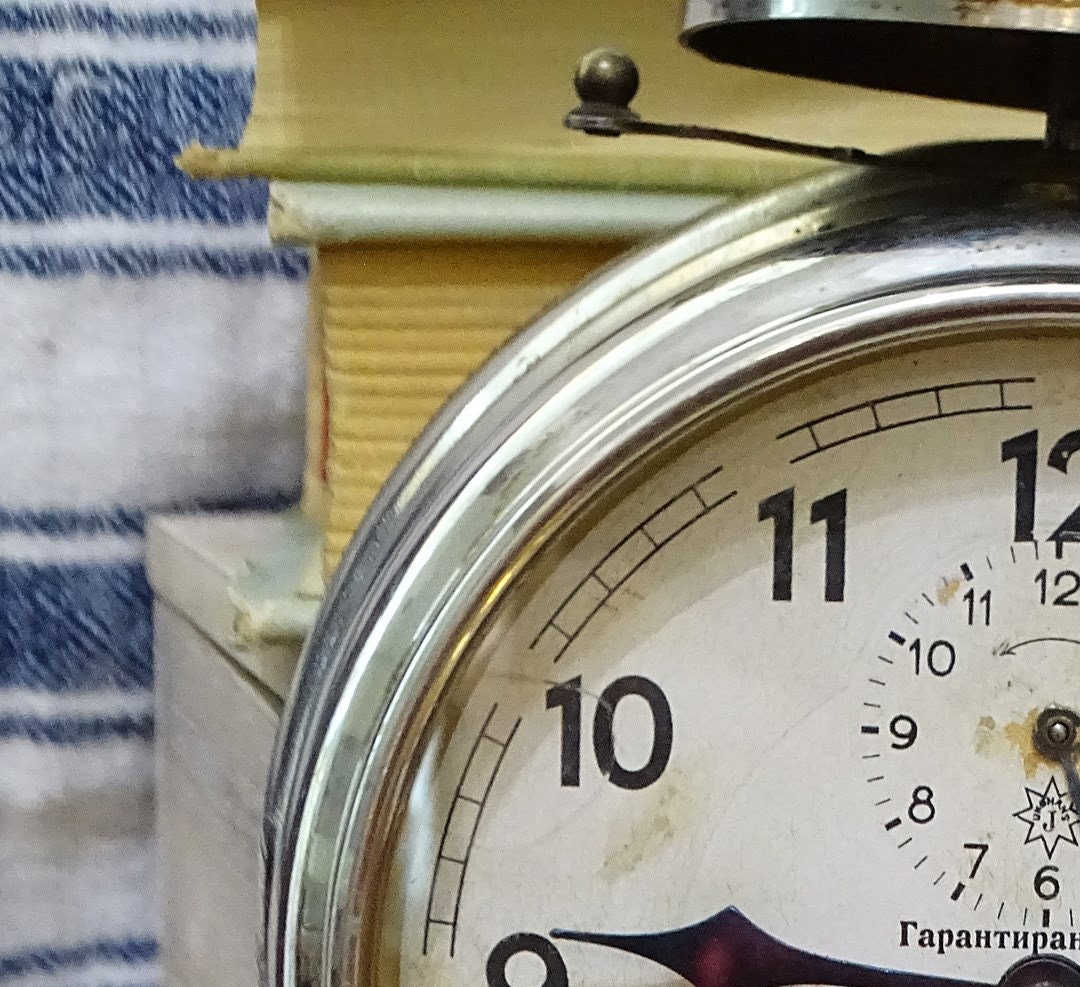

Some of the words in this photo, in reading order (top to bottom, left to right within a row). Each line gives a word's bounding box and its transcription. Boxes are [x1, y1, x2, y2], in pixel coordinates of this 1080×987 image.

[757, 485, 848, 603] 11
[962, 587, 992, 627] 11
[1034, 568, 1080, 607] 12
[909, 637, 956, 677] 10
[543, 674, 674, 791] 10
[889, 713, 918, 750] 9
[907, 785, 936, 825] 8
[963, 843, 989, 879] 7
[1033, 865, 1060, 901] 6
